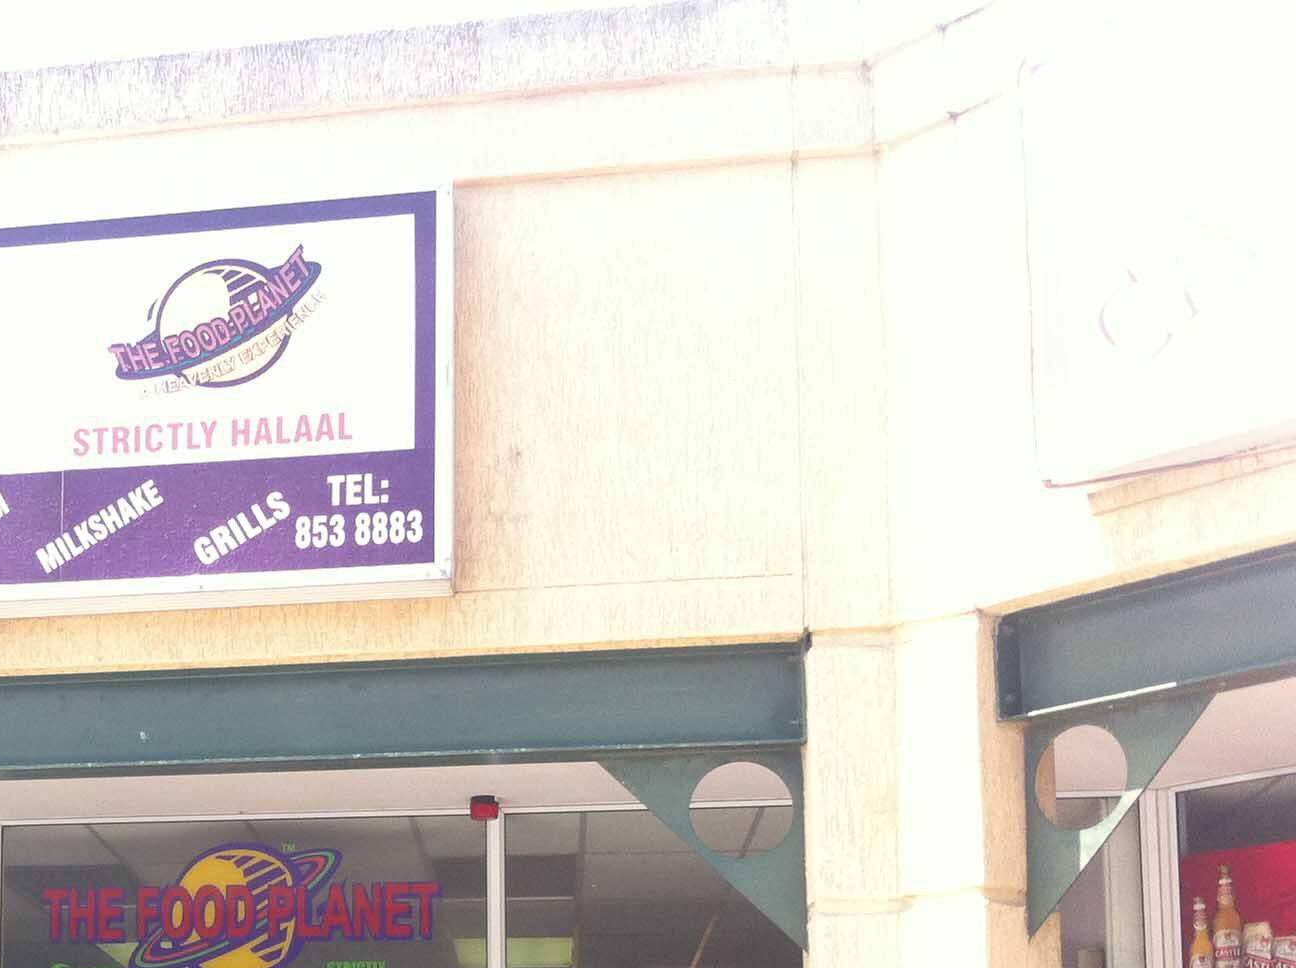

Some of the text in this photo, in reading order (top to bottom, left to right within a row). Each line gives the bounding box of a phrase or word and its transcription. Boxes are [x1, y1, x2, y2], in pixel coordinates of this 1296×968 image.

[163, 317, 231, 365] FOOD
[229, 248, 310, 336] PLANET
[73, 412, 353, 457] STRICTLY HALAAL
[326, 473, 390, 507] TEL:
[35, 480, 165, 574] MILKSHAKE
[192, 491, 291, 567] GRILLS
[294, 509, 424, 549] 853 8883
[43, 880, 442, 942] THE FOOD PLANET
